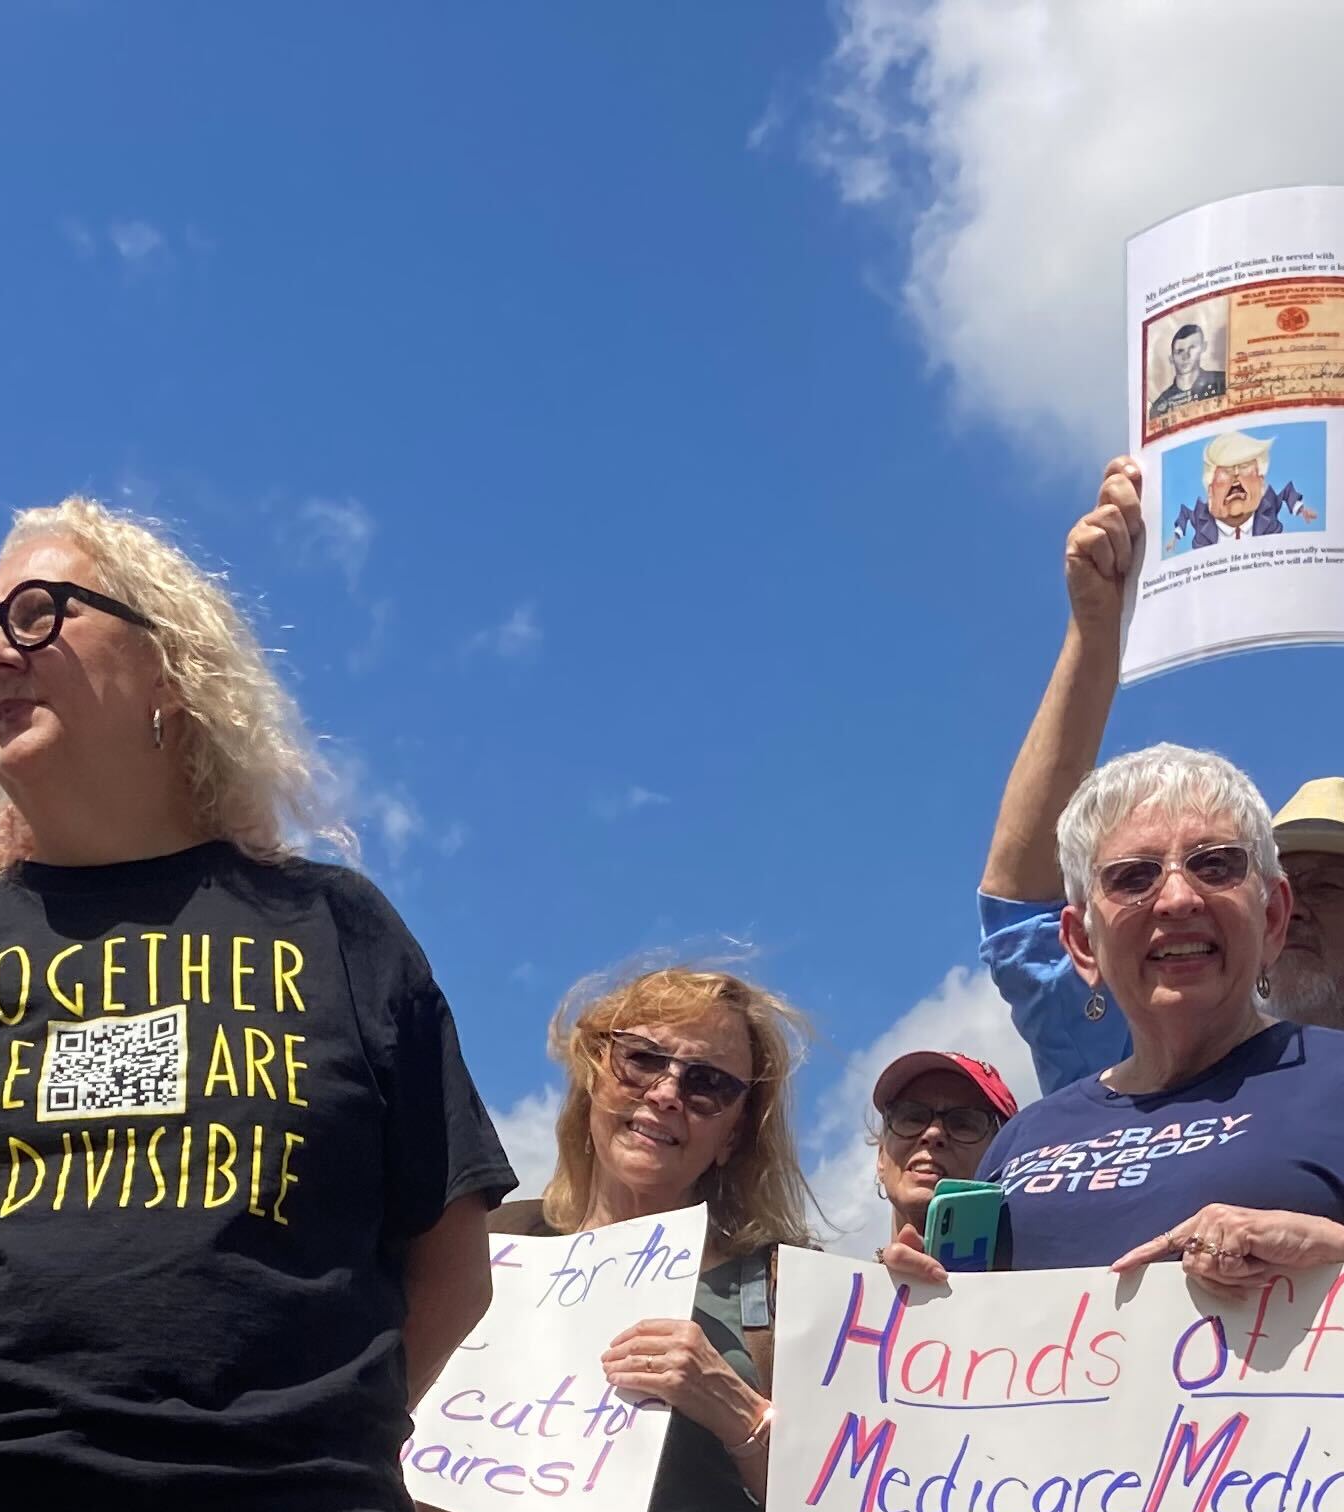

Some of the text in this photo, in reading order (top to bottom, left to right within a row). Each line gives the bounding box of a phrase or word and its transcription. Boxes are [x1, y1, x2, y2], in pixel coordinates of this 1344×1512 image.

[1159, 281, 1180, 296] father
[1272, 254, 1284, 263] He
[1286, 252, 1314, 261] served
[1316, 252, 1335, 260] with
[1288, 264, 1316, 272] sucker
[1142, 573, 1166, 590] Donald
[1168, 566, 1193, 579] Trump
[1231, 554, 1241, 562] He
[1251, 551, 1274, 559] trying
[204, 1024, 309, 1108] ARE
[1002, 1162, 1153, 1196] VOTES
[536, 1223, 698, 1309] for the
[822, 1272, 1127, 1404] Hands
[441, 1374, 577, 1438] cut
